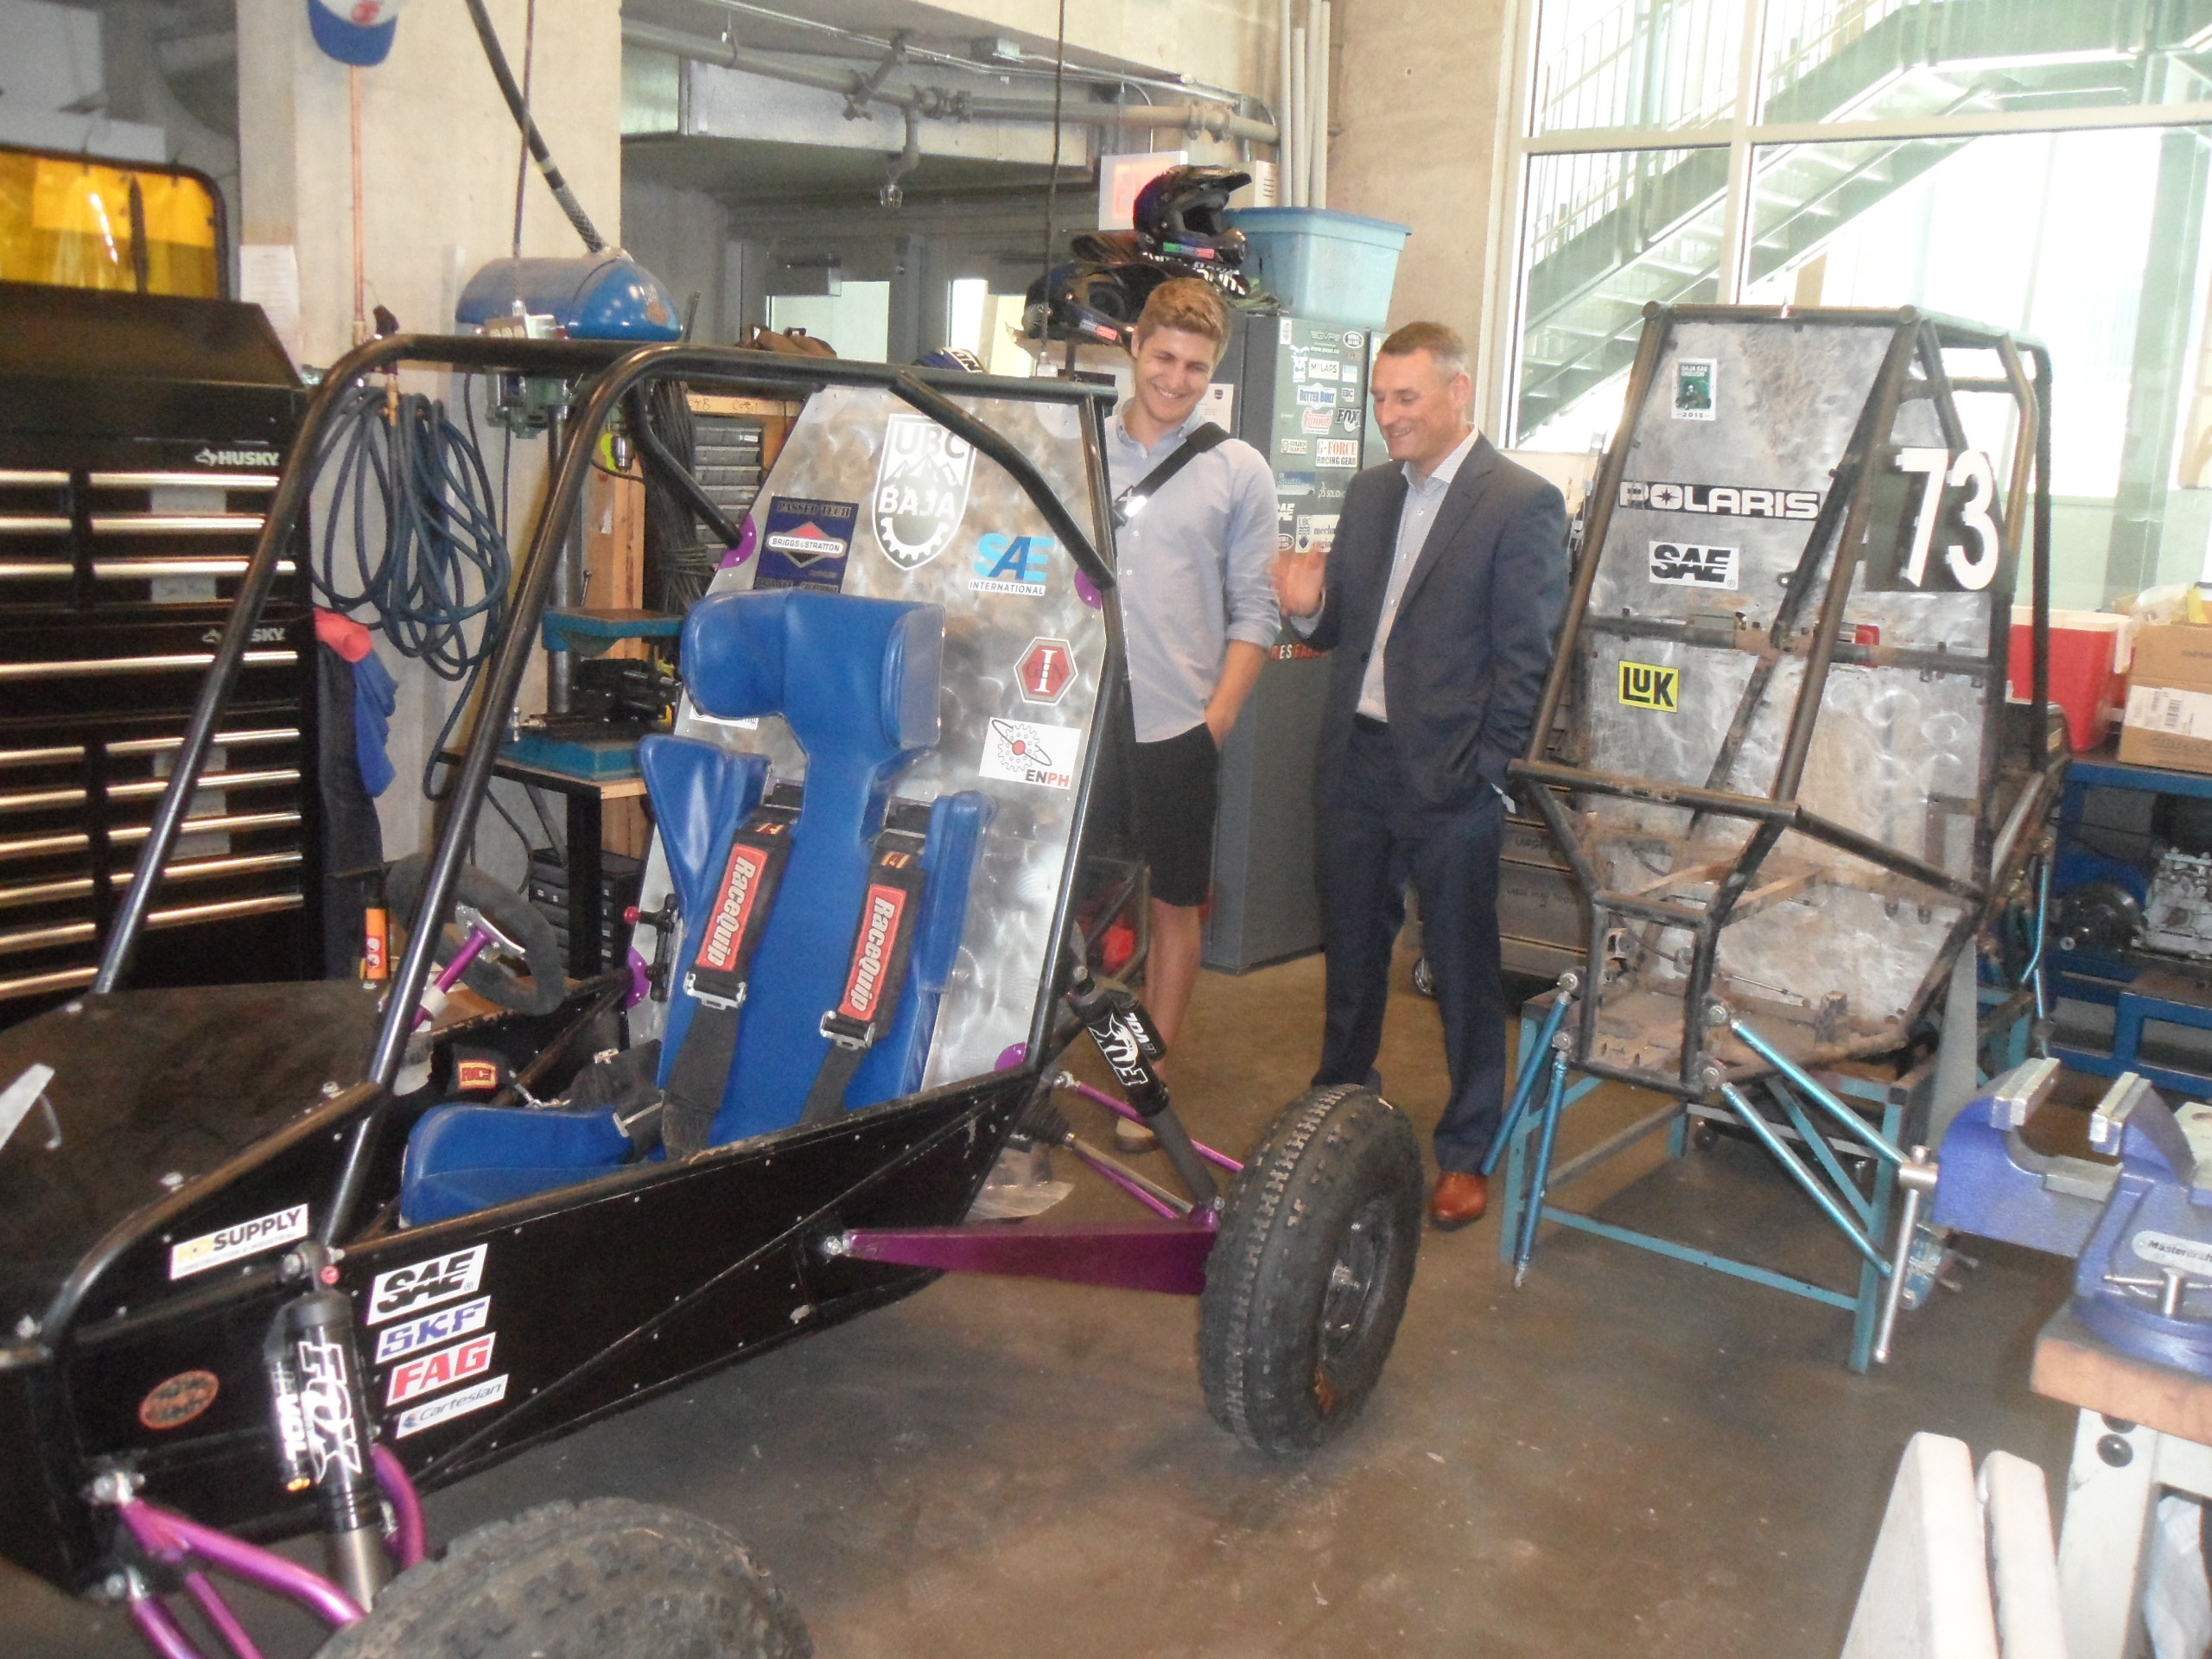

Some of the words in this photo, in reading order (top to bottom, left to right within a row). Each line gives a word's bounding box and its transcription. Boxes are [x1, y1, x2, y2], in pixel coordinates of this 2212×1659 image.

[1311, 363, 1338, 373] MYLAPS
[1336, 408, 1362, 424] FOX
[219, 451, 280, 467] HUSKY
[895, 424, 966, 459] UBC
[1316, 456, 1340, 465] RACING
[1341, 456, 1357, 466] GEAR
[1317, 441, 1357, 455] G-FORCE
[878, 484, 957, 518] BAJA
[1619, 481, 1819, 519] POLARIS
[1895, 448, 1999, 590] 73
[974, 532, 1056, 582] SAE
[1651, 543, 1732, 583] SAE
[969, 580, 1045, 595] INTERNATIONAL
[251, 628, 285, 642] SKY
[1025, 769, 1071, 787] ENPH
[707, 856, 756, 967] RaceQuip
[850, 896, 895, 1012] RaceQuip
[1088, 1013, 1149, 1085] FOX
[213, 1207, 302, 1251] SUPPLY
[377, 1250, 476, 1313] SAE
[381, 1300, 486, 1357] SKF
[391, 1338, 491, 1400] FAG
[297, 1341, 363, 1484] FOX
[418, 1382, 502, 1421] Cartesian
